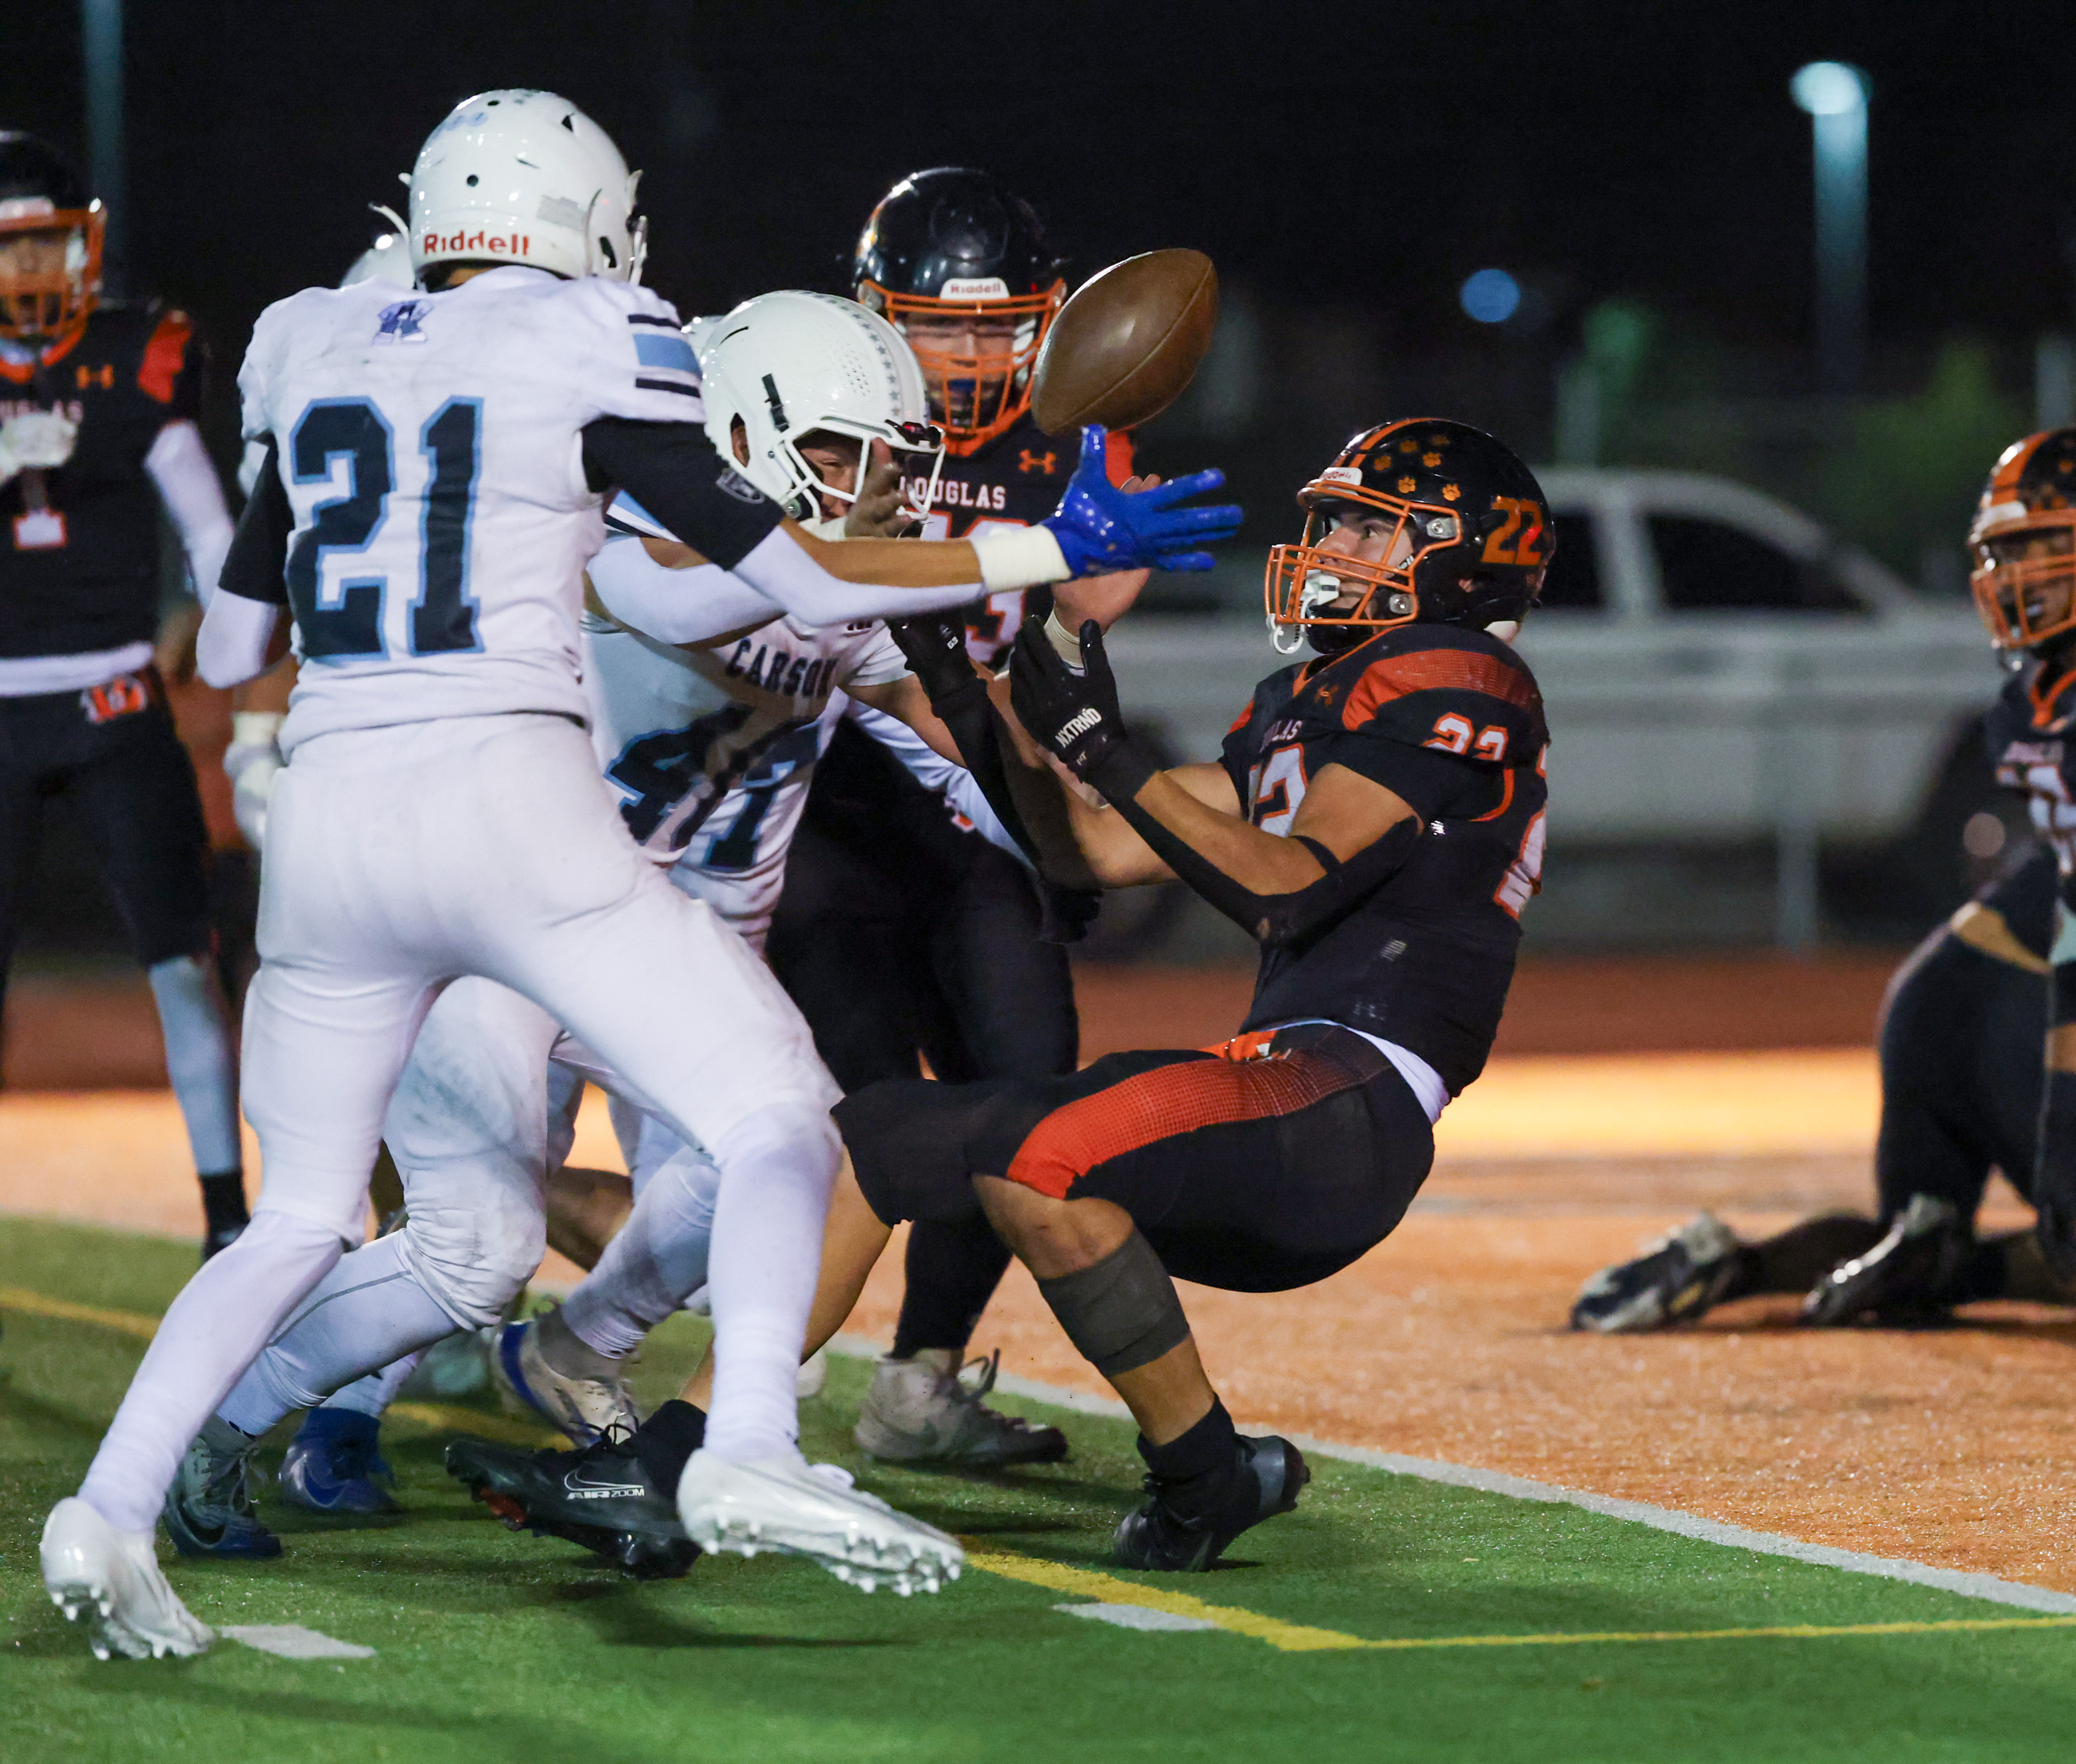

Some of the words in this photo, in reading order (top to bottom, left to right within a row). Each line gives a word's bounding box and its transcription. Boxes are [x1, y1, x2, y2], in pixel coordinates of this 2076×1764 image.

[424, 230, 529, 256] Riddell
[899, 475, 1006, 510] OUGLAS
[283, 395, 485, 661] 21
[1480, 496, 1543, 565] 22
[1054, 707, 1103, 749] NXTRND
[567, 1490, 610, 1500] AIR
[611, 1488, 645, 1498] ZOOM
